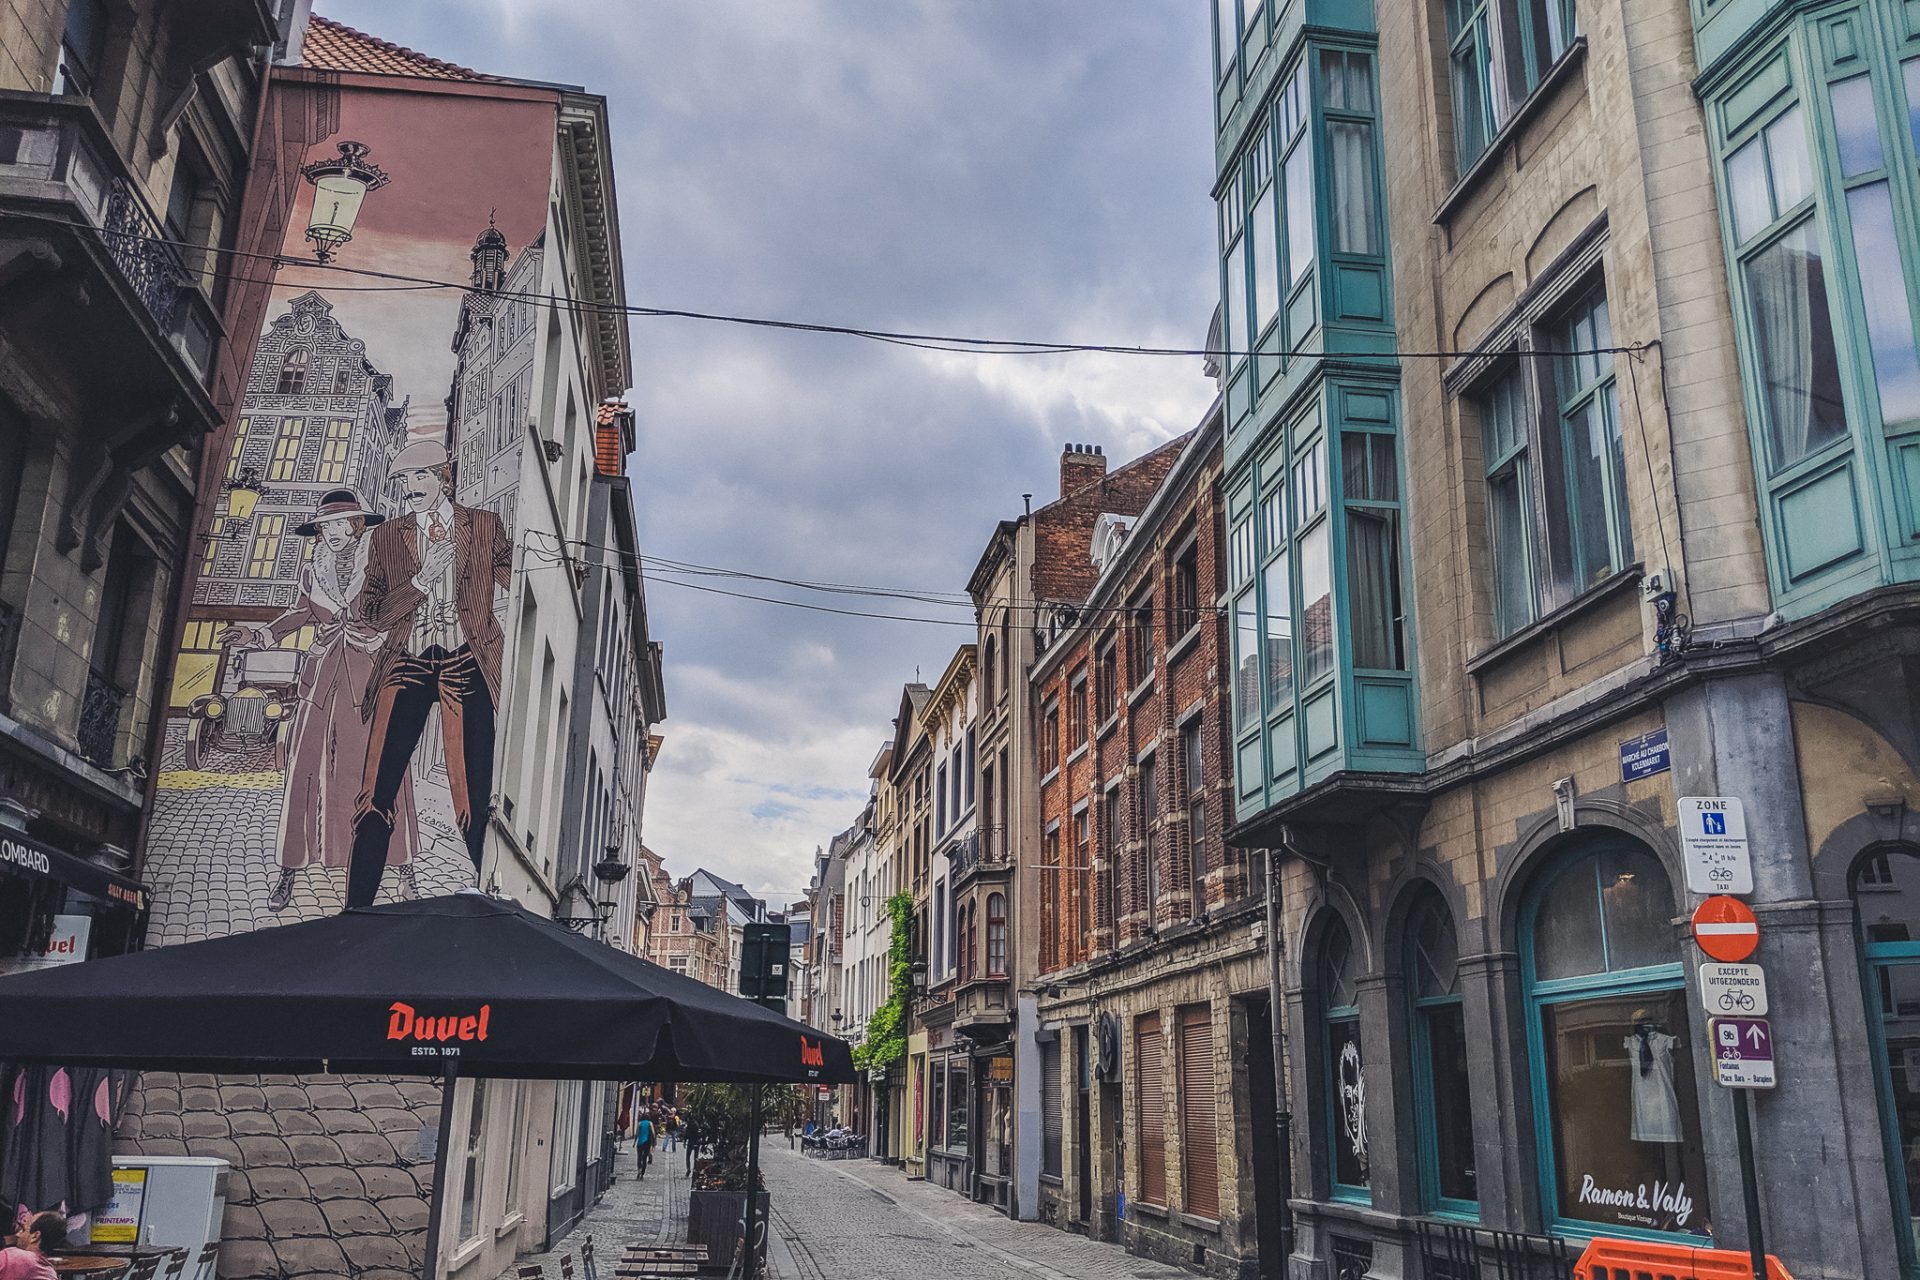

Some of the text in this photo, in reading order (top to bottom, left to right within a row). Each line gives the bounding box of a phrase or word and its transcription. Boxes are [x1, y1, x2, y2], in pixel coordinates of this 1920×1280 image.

[1696, 801, 1727, 810] ZONE
[0, 840, 49, 874] OMBARD
[45, 935, 76, 954] vel
[1718, 968, 1749, 976] EXCEPTE
[1708, 977, 1760, 986] UITGEZONDERD
[387, 1001, 490, 1041] Duvel
[1723, 1030, 1735, 1040] 9b
[411, 1047, 460, 1056] ESTD. 1871
[1720, 1074, 1732, 1082] Place
[1734, 1074, 1745, 1082] Bara
[1579, 1174, 1693, 1226] Ramon & Valy
[96, 1217, 135, 1225] PRINTEMPS
